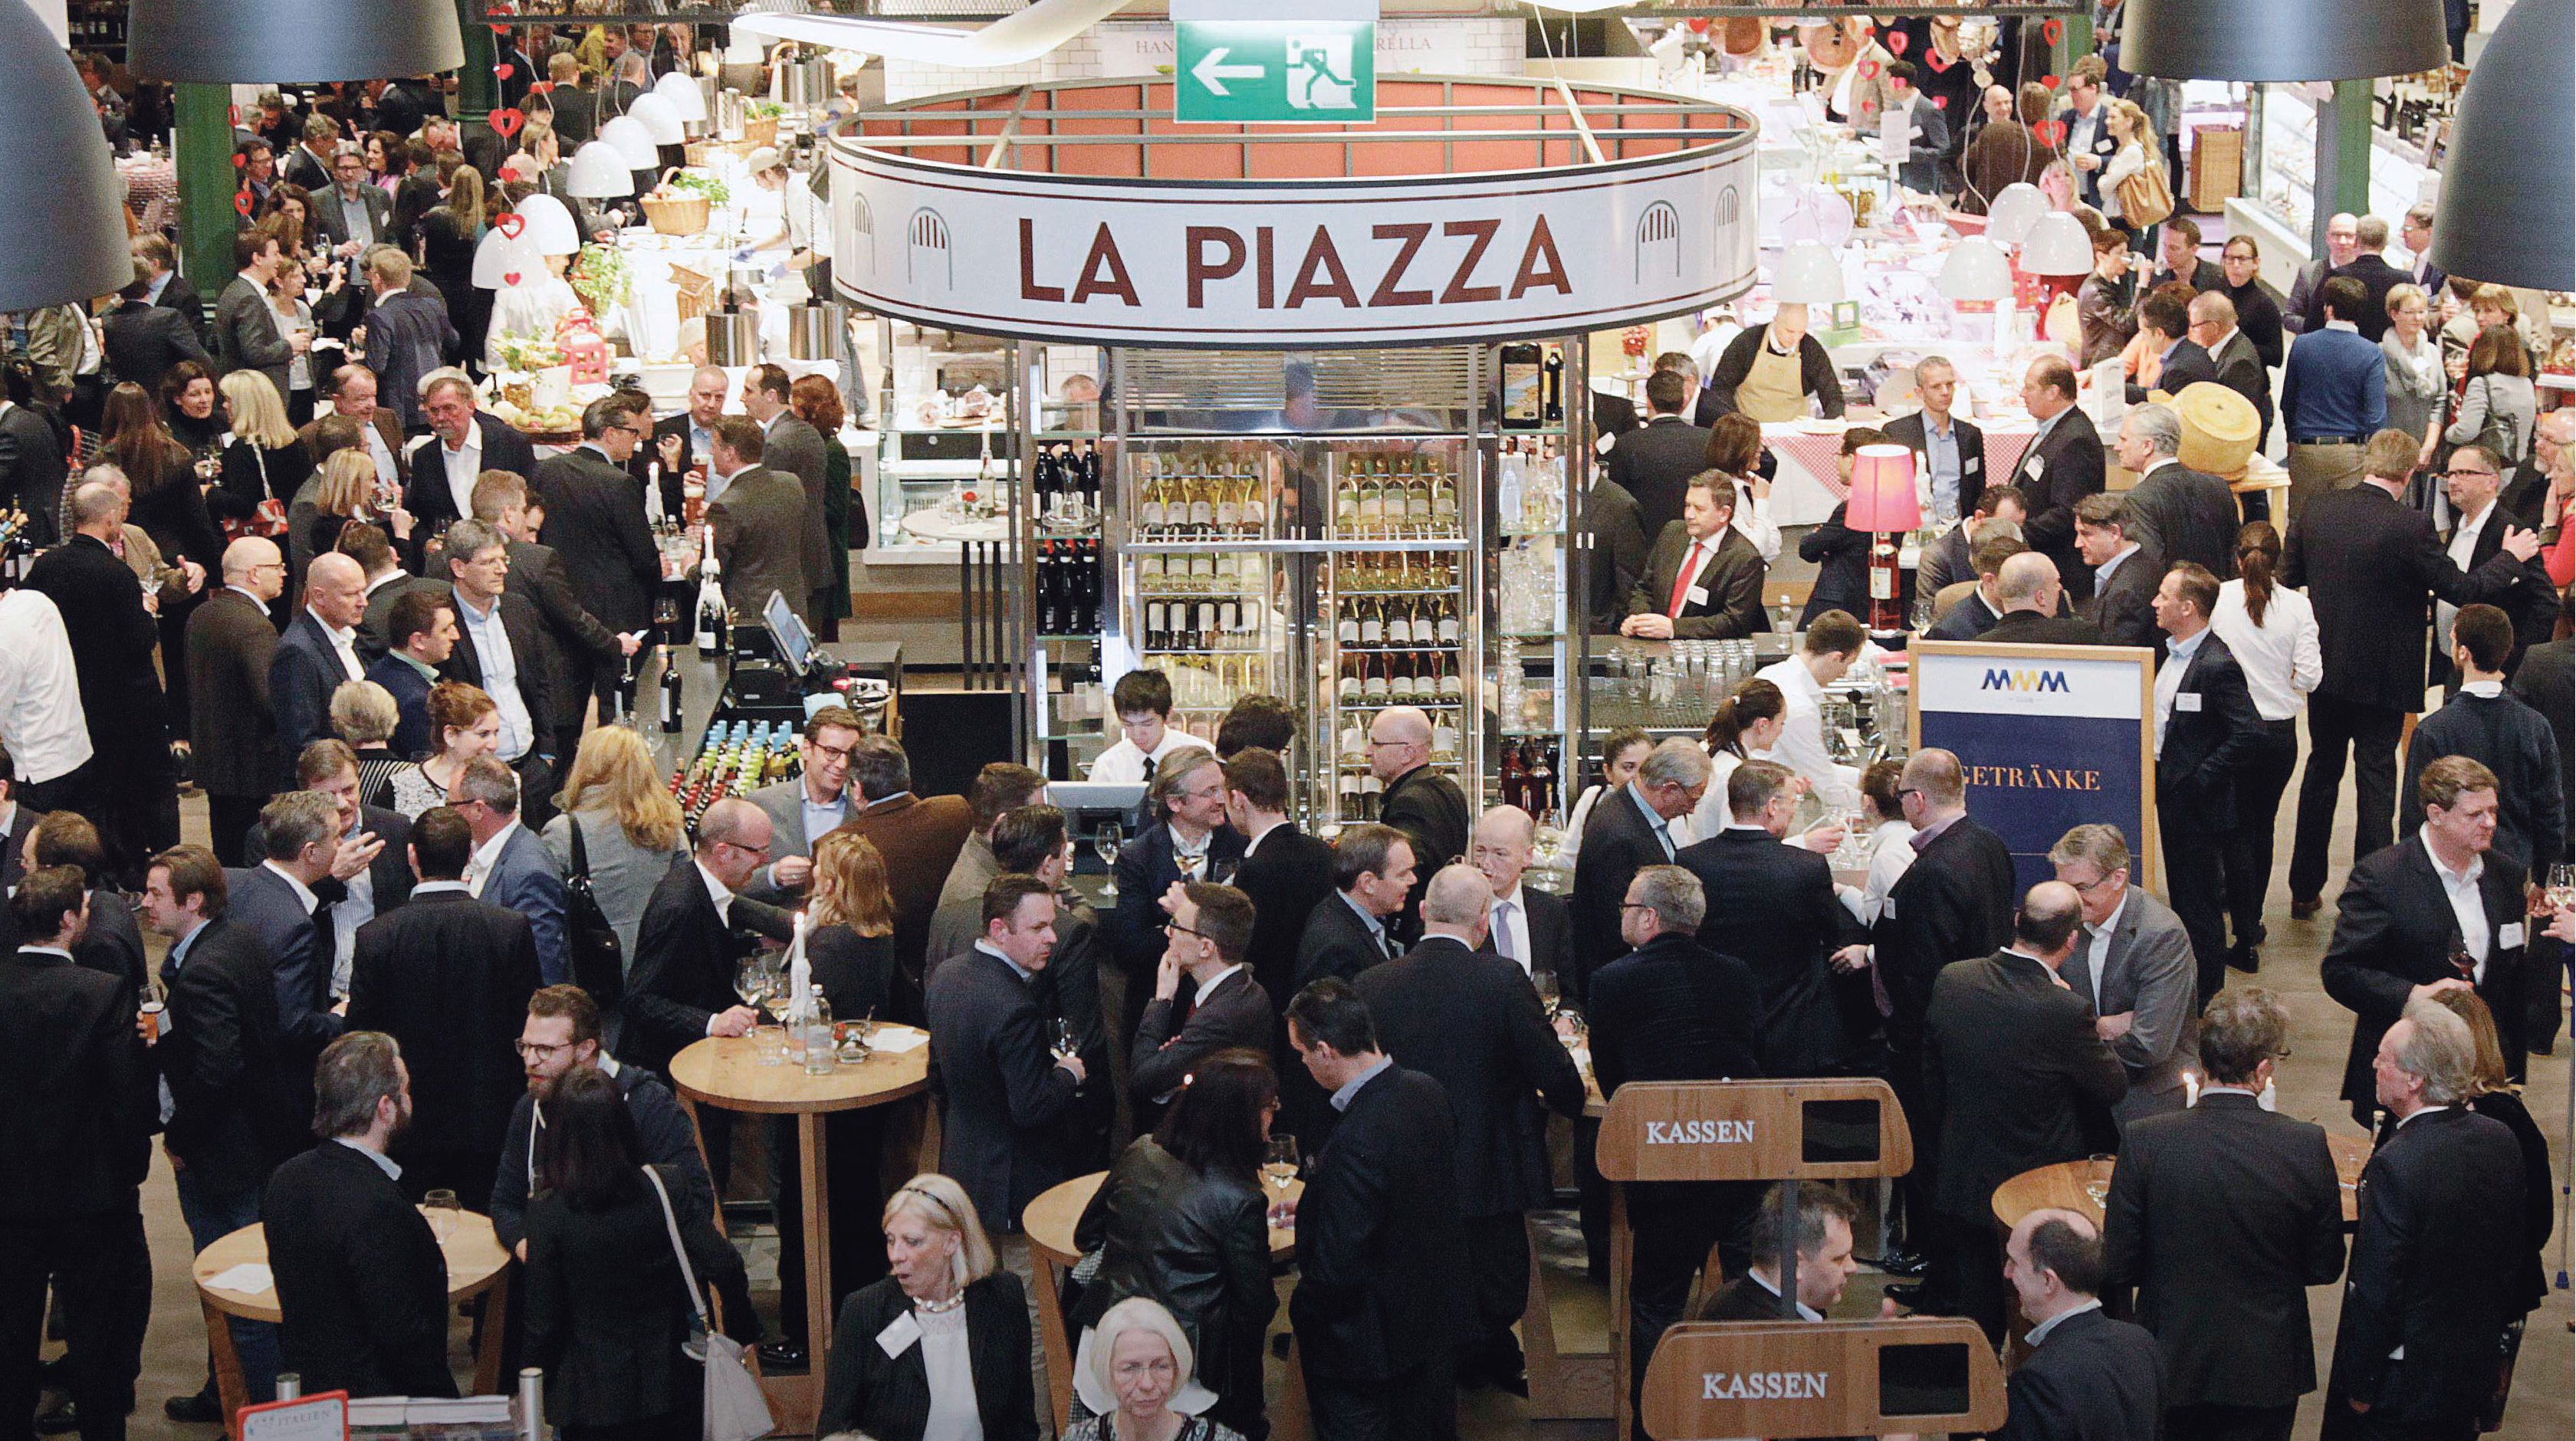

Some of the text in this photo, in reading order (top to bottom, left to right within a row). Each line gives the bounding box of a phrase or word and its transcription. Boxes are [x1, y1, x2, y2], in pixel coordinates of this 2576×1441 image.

[1376, 36, 1432, 50] RELLA
[1019, 214, 1572, 310] LA PIAZZA
[1645, 1119, 1756, 1145] KASSEN
[1701, 1371, 1829, 1400] KASSEN
